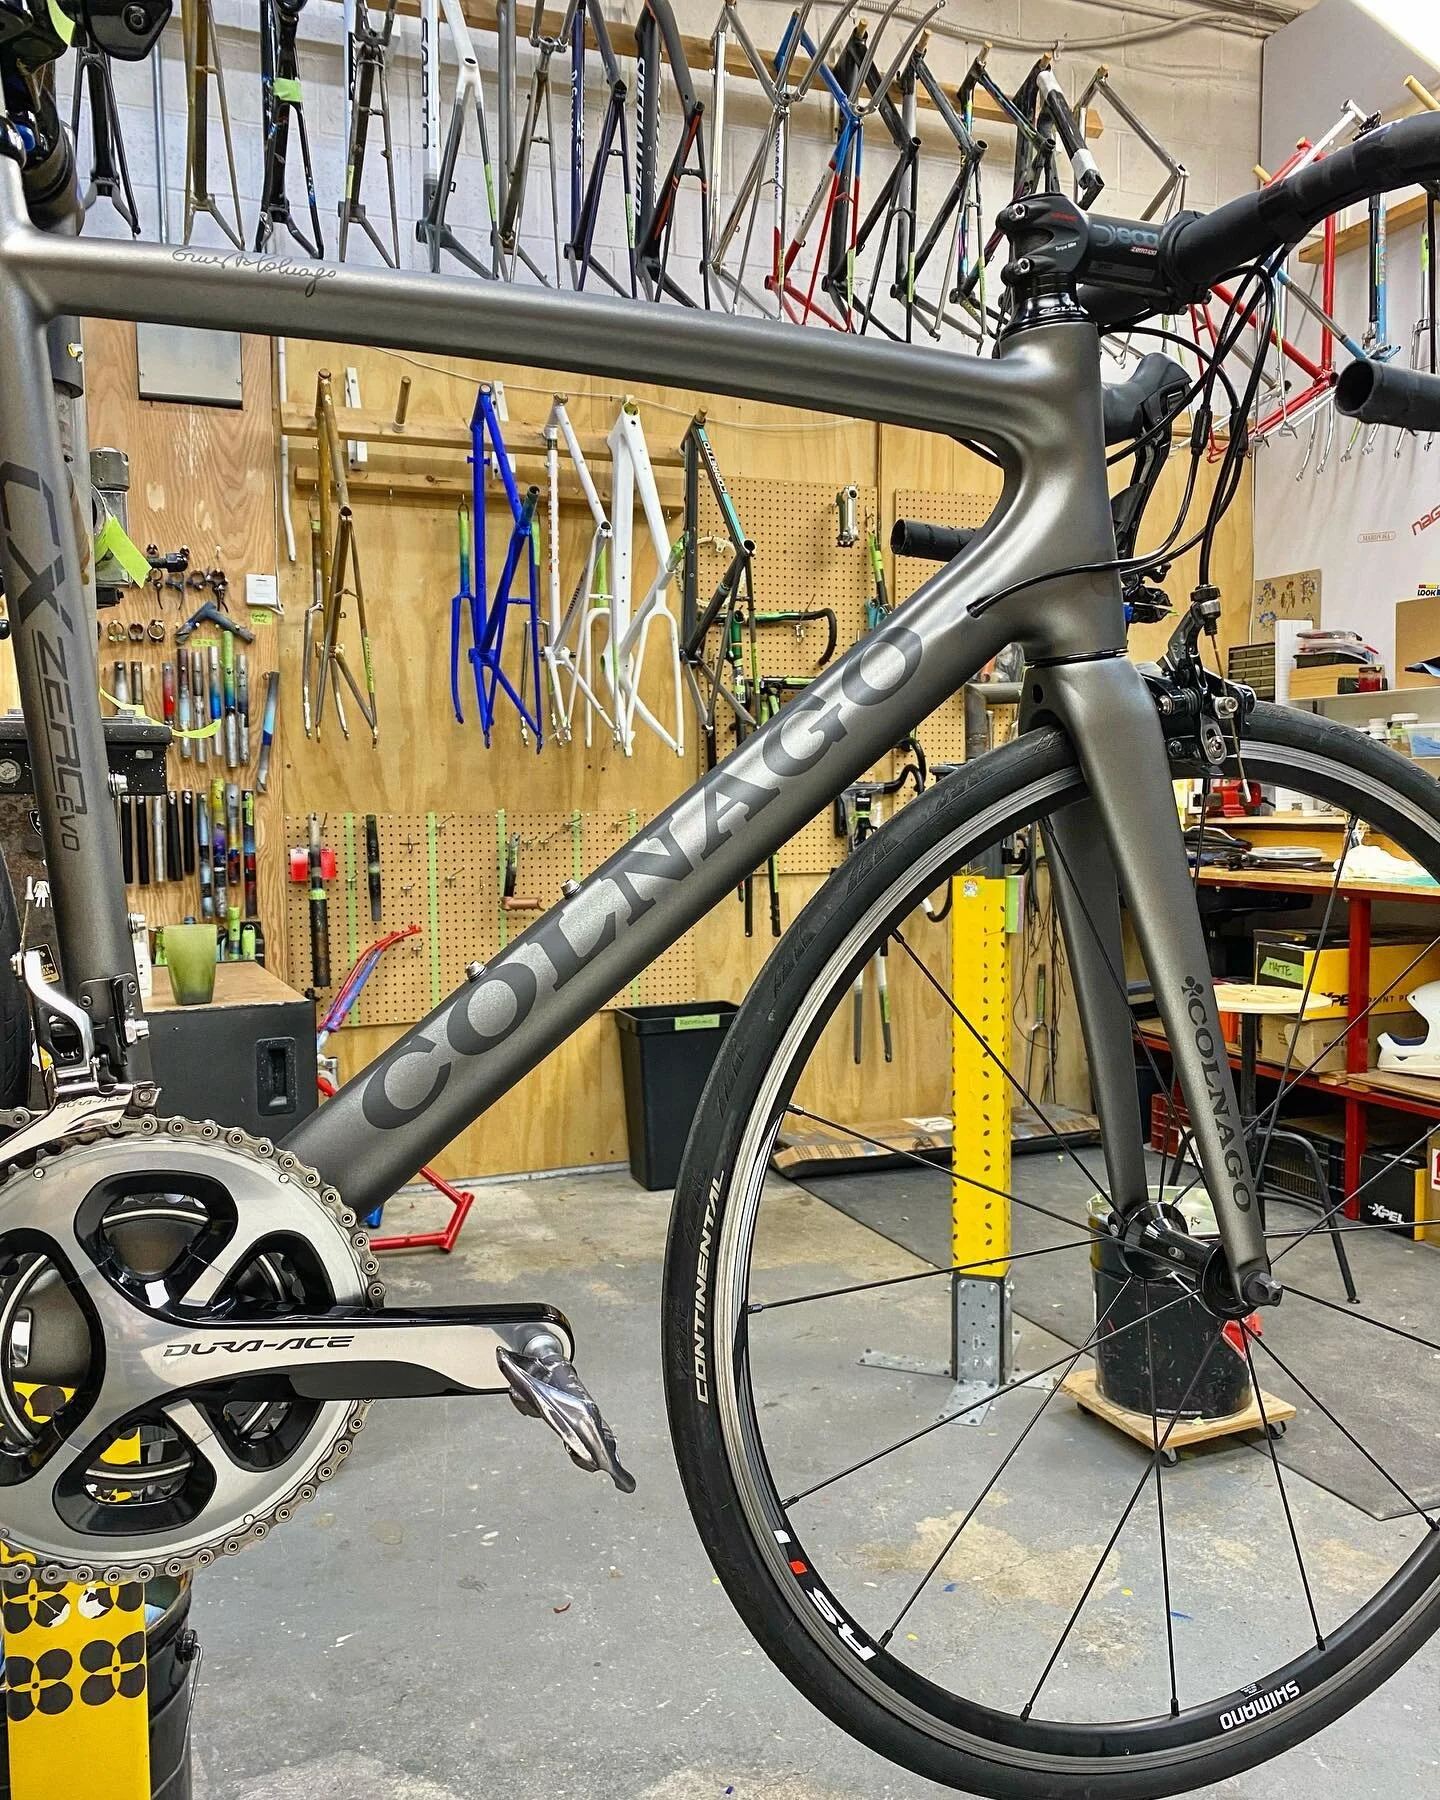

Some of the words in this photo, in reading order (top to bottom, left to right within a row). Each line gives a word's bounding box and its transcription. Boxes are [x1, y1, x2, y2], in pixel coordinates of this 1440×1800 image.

[1417, 588, 1437, 597] LOOK
[54, 802, 80, 853] EVO
[361, 626, 923, 1131] COLNAGO
[1268, 960, 1292, 977] MATTE
[1187, 997, 1251, 1213] COLNAGO
[1371, 1203, 1406, 1225] XPEL
[694, 1170, 725, 1405] CONTINENTAL
[163, 1335, 355, 1357] DURA-ACE
[1219, 1679, 1301, 1731] SHIMANO
